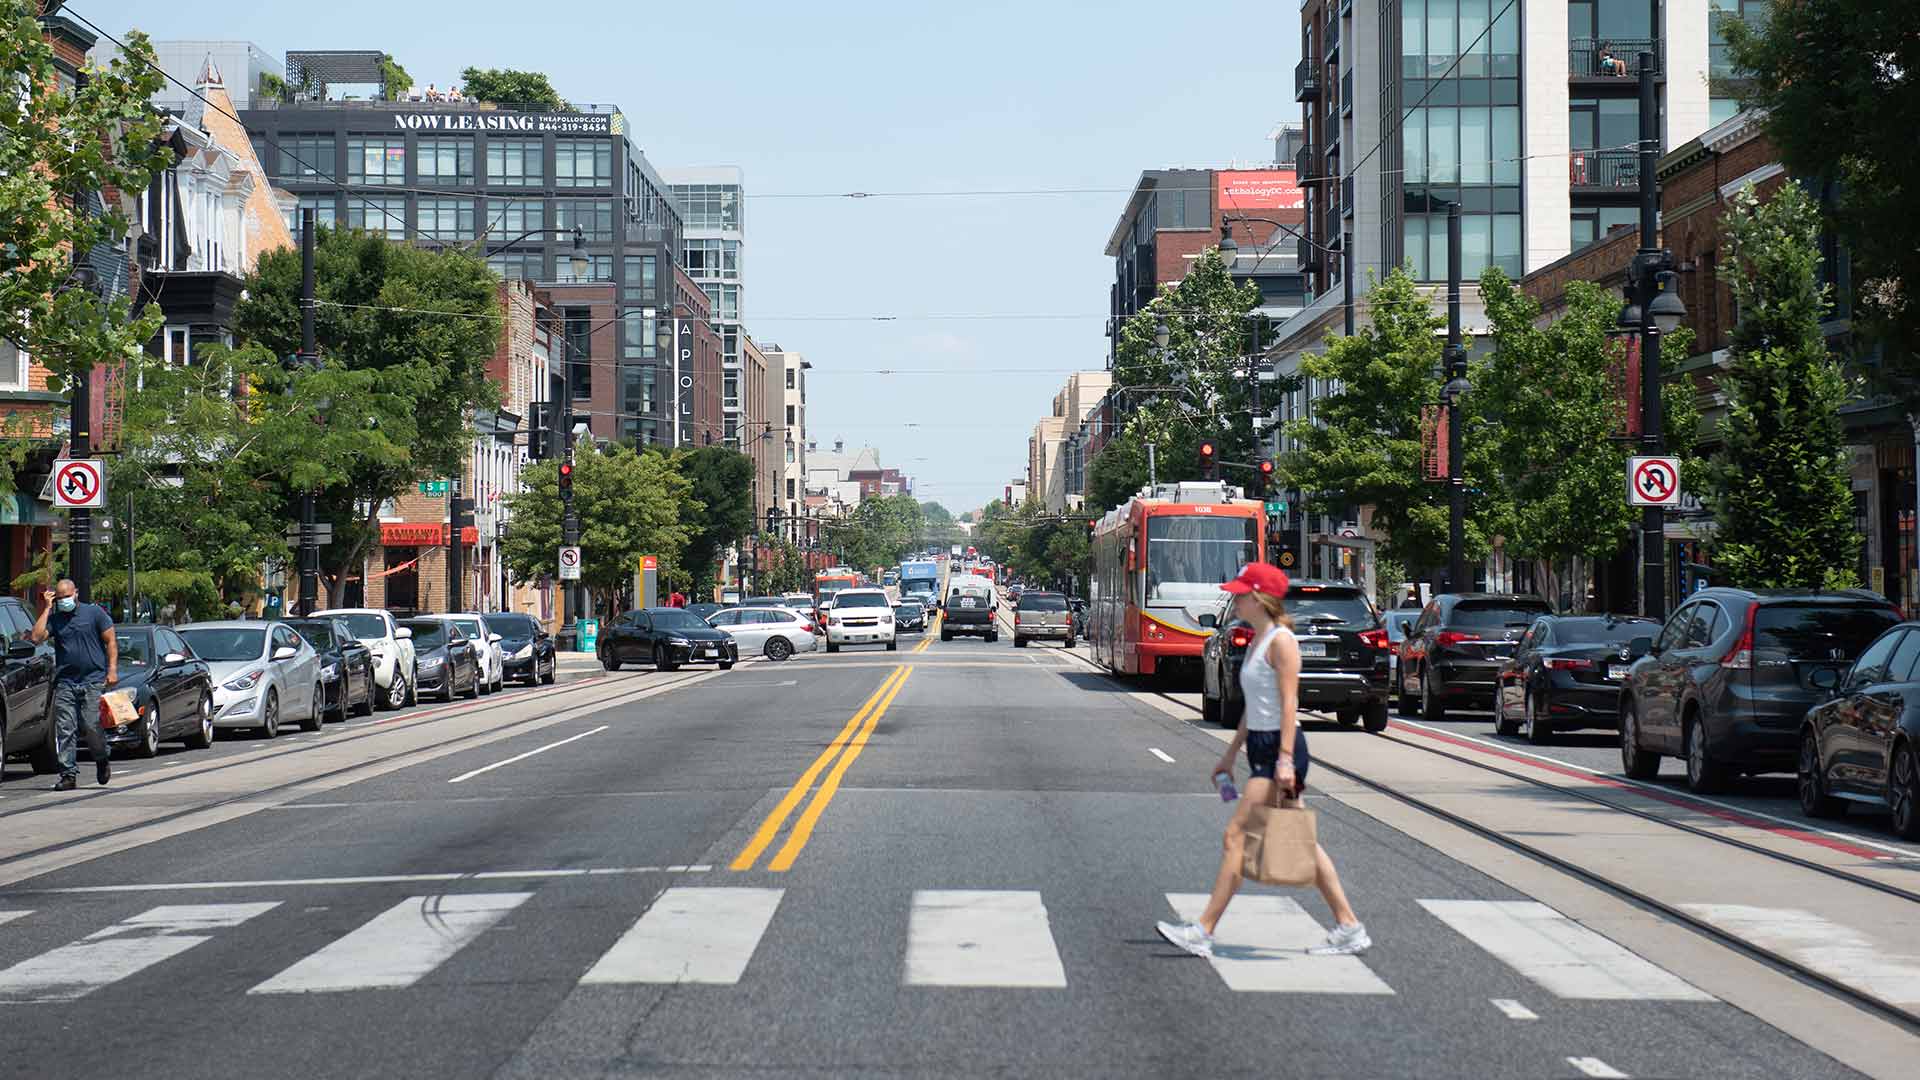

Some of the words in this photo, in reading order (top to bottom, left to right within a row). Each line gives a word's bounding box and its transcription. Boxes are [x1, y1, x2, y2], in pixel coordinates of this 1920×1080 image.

[394, 115, 441, 129] NOW
[444, 115, 534, 130] LEASING
[539, 123, 607, 131] 844-319-8454
[680, 324, 692, 441] APOLL
